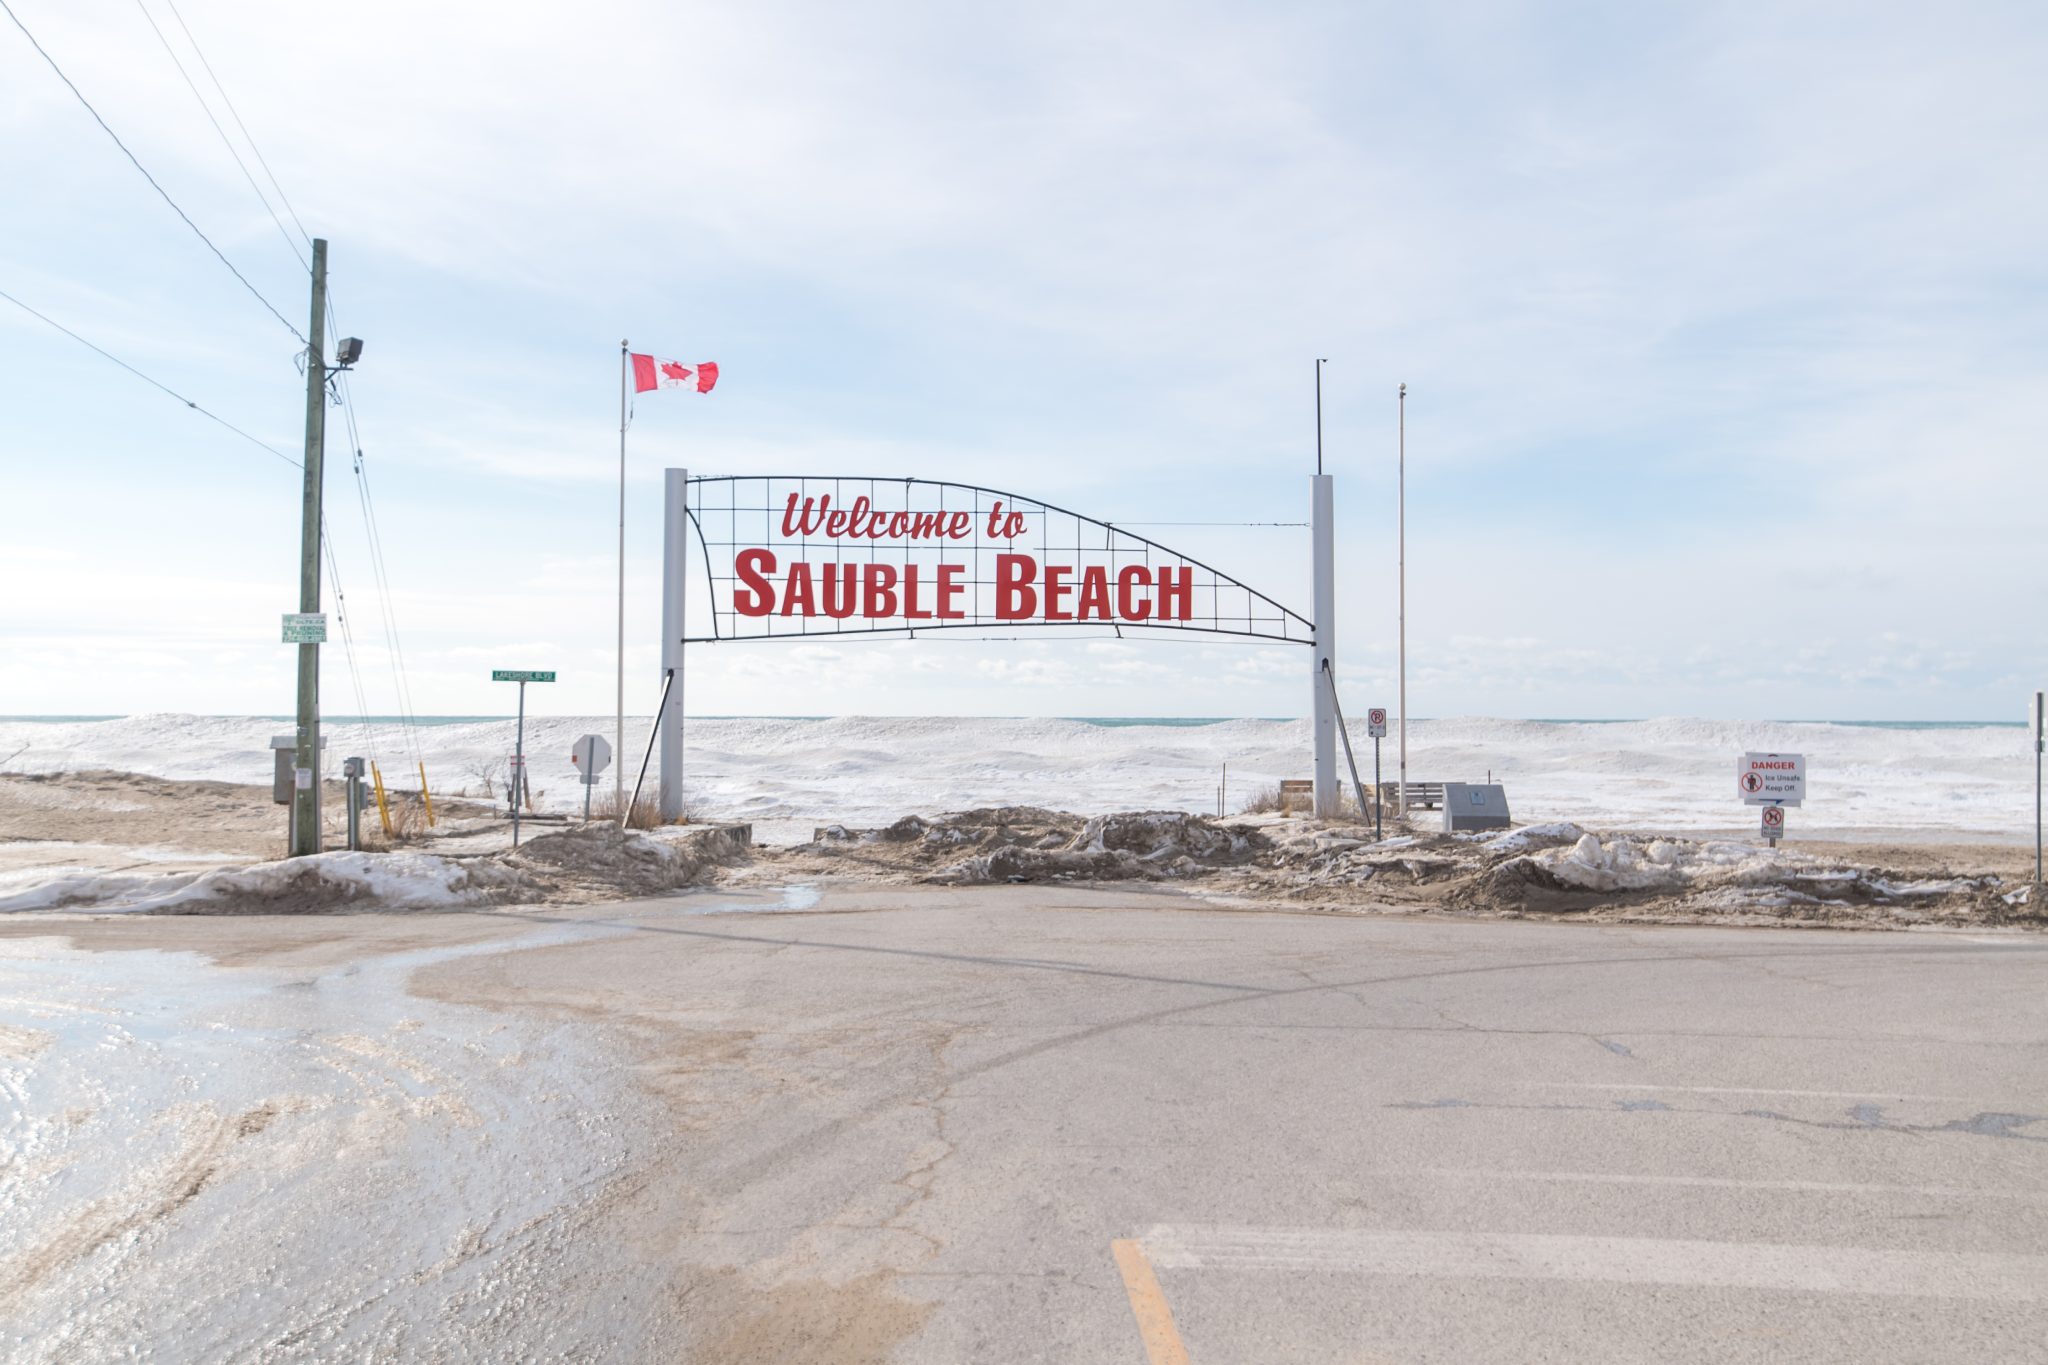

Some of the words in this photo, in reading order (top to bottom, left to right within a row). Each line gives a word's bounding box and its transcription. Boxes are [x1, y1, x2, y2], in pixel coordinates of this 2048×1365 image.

[781, 492, 971, 540] Welcome
[986, 501, 1027, 539] to
[734, 548, 965, 619] SAUBLE
[996, 553, 1192, 621] BEACH
[535, 671, 552, 679] BLVD
[1751, 761, 1795, 769] DANGER
